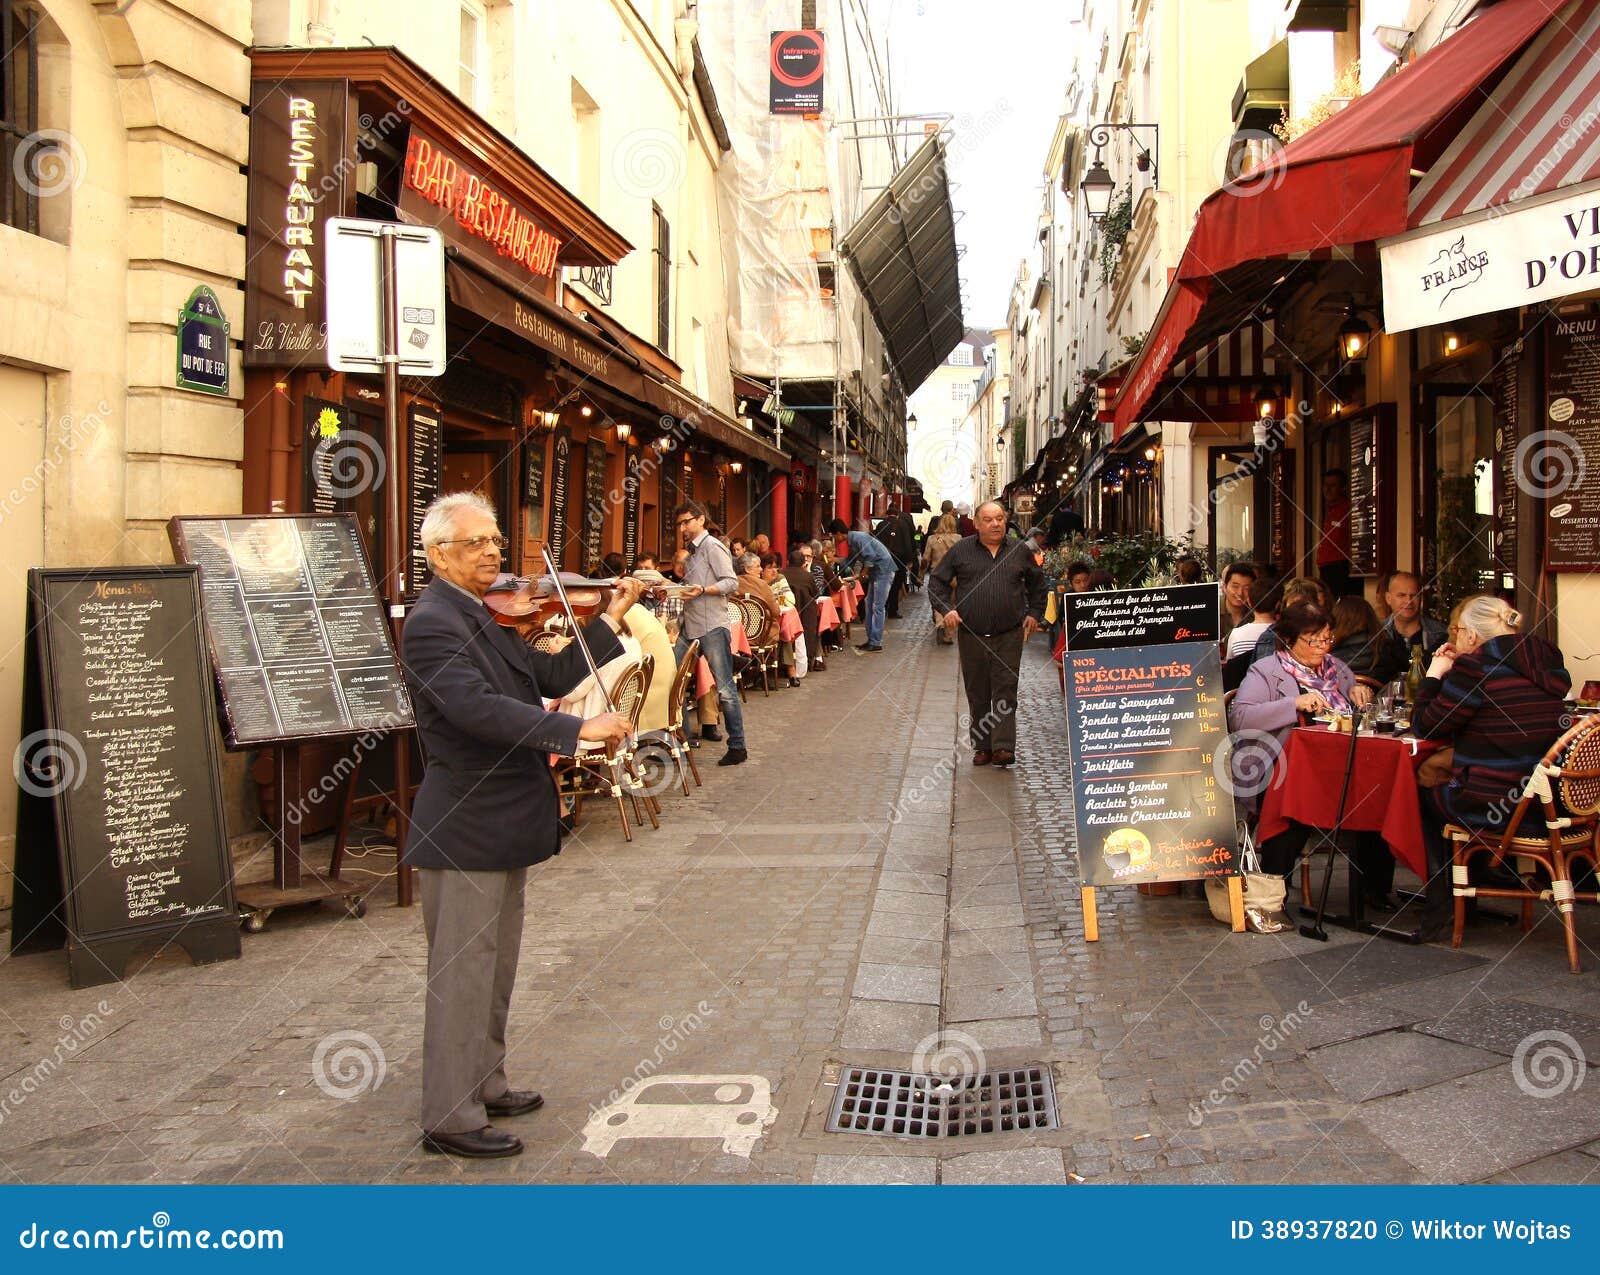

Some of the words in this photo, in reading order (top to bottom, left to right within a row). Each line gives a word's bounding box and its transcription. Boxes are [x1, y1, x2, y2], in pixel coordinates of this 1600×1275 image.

[285, 95, 317, 309] RESTAURANT
[411, 138, 458, 208] BAR
[463, 173, 563, 280] RESTAURANT
[1420, 250, 1489, 292] FRANCE
[254, 321, 275, 350] La
[278, 322, 314, 350] Vieille
[1556, 319, 1596, 335] MENU
[198, 333, 212, 350] RUE
[514, 302, 567, 353] Restaurant
[572, 338, 609, 377] Français
[182, 353, 192, 369] DU
[193, 356, 205, 372] POT
[205, 359, 213, 374] DE
[214, 361, 225, 376] FER
[1568, 418, 1586, 426] PLATS
[1075, 597, 1112, 609] Grillades
[1126, 595, 1139, 605] feu
[1140, 593, 1151, 603] de
[1152, 592, 1168, 602] bois
[1094, 607, 1131, 618] Poissons
[1132, 605, 1155, 616] frais
[1076, 620, 1099, 630] Plats
[1100, 618, 1135, 629] typiques
[1136, 615, 1174, 626] Français
[1094, 629, 1127, 639] Salades
[1127, 627, 1146, 636] d'été
[1072, 658, 1096, 667] NOS
[1074, 661, 1192, 684] SPÉCIALITÉS
[1195, 675, 1205, 687] €
[1077, 699, 1117, 713] Fondue
[1119, 694, 1175, 710] Savoyarde
[1079, 714, 1119, 729] Fondue
[1080, 729, 1120, 743] Fondue
[1121, 724, 1171, 738] Landaise
[1082, 760, 1135, 774] Tartiflette
[1201, 753, 1212, 764] 16
[1084, 784, 1126, 795] Raclette
[1127, 781, 1168, 795] Jambon
[1204, 777, 1215, 787] 16
[1085, 798, 1127, 810] Raclette
[1130, 797, 1166, 809] Grison
[1204, 791, 1215, 802] 20
[1087, 813, 1128, 825] Raclette
[1130, 809, 1192, 824] Charcuterie
[1206, 806, 1216, 817] 17
[111, 846, 134, 858] Steak
[1157, 837, 1215, 854] Fontaine
[1185, 847, 1232, 866] Mouffe
[126, 874, 148, 883] Crème
[149, 866, 175, 881] Caramel
